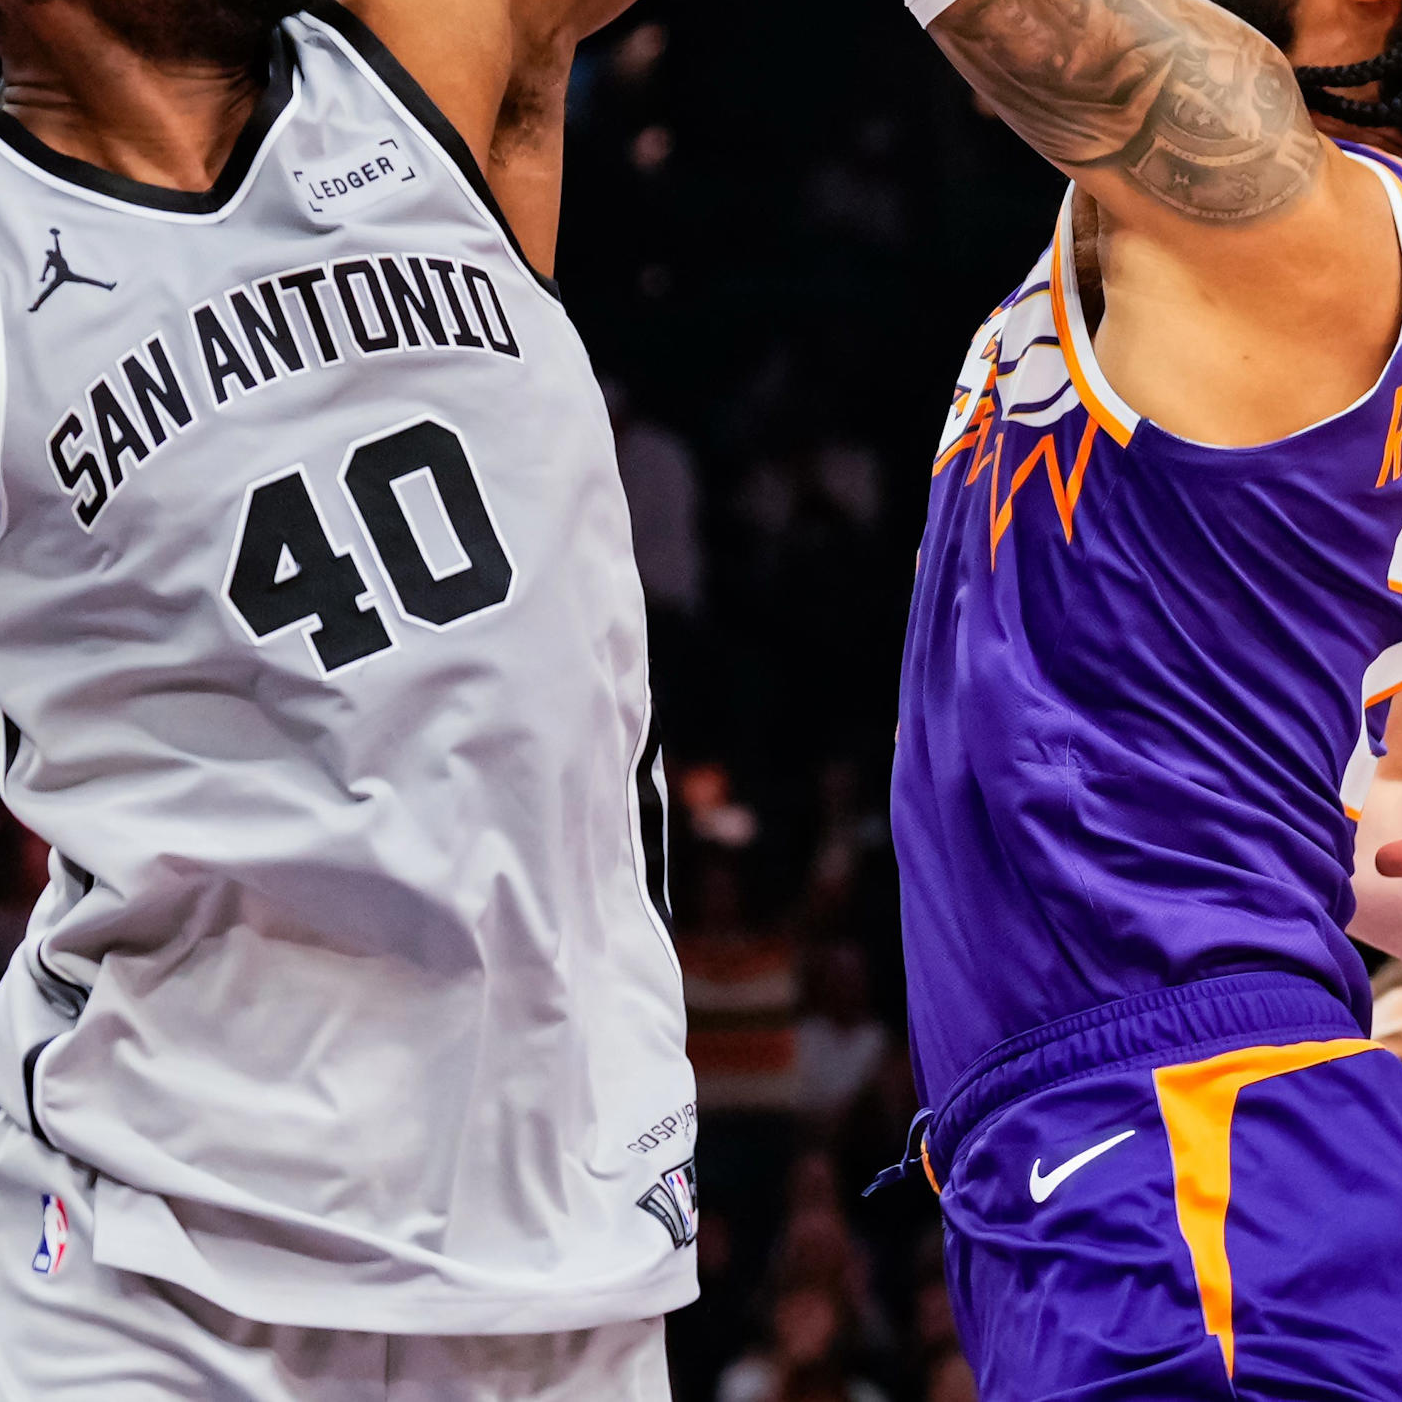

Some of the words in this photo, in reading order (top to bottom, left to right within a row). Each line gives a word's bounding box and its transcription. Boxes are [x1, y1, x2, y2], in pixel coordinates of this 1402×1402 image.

[308, 156, 395, 200] LEDGER
[46, 331, 196, 534] SAN
[188, 254, 524, 411] ANTONIO
[220, 412, 518, 681] 40
